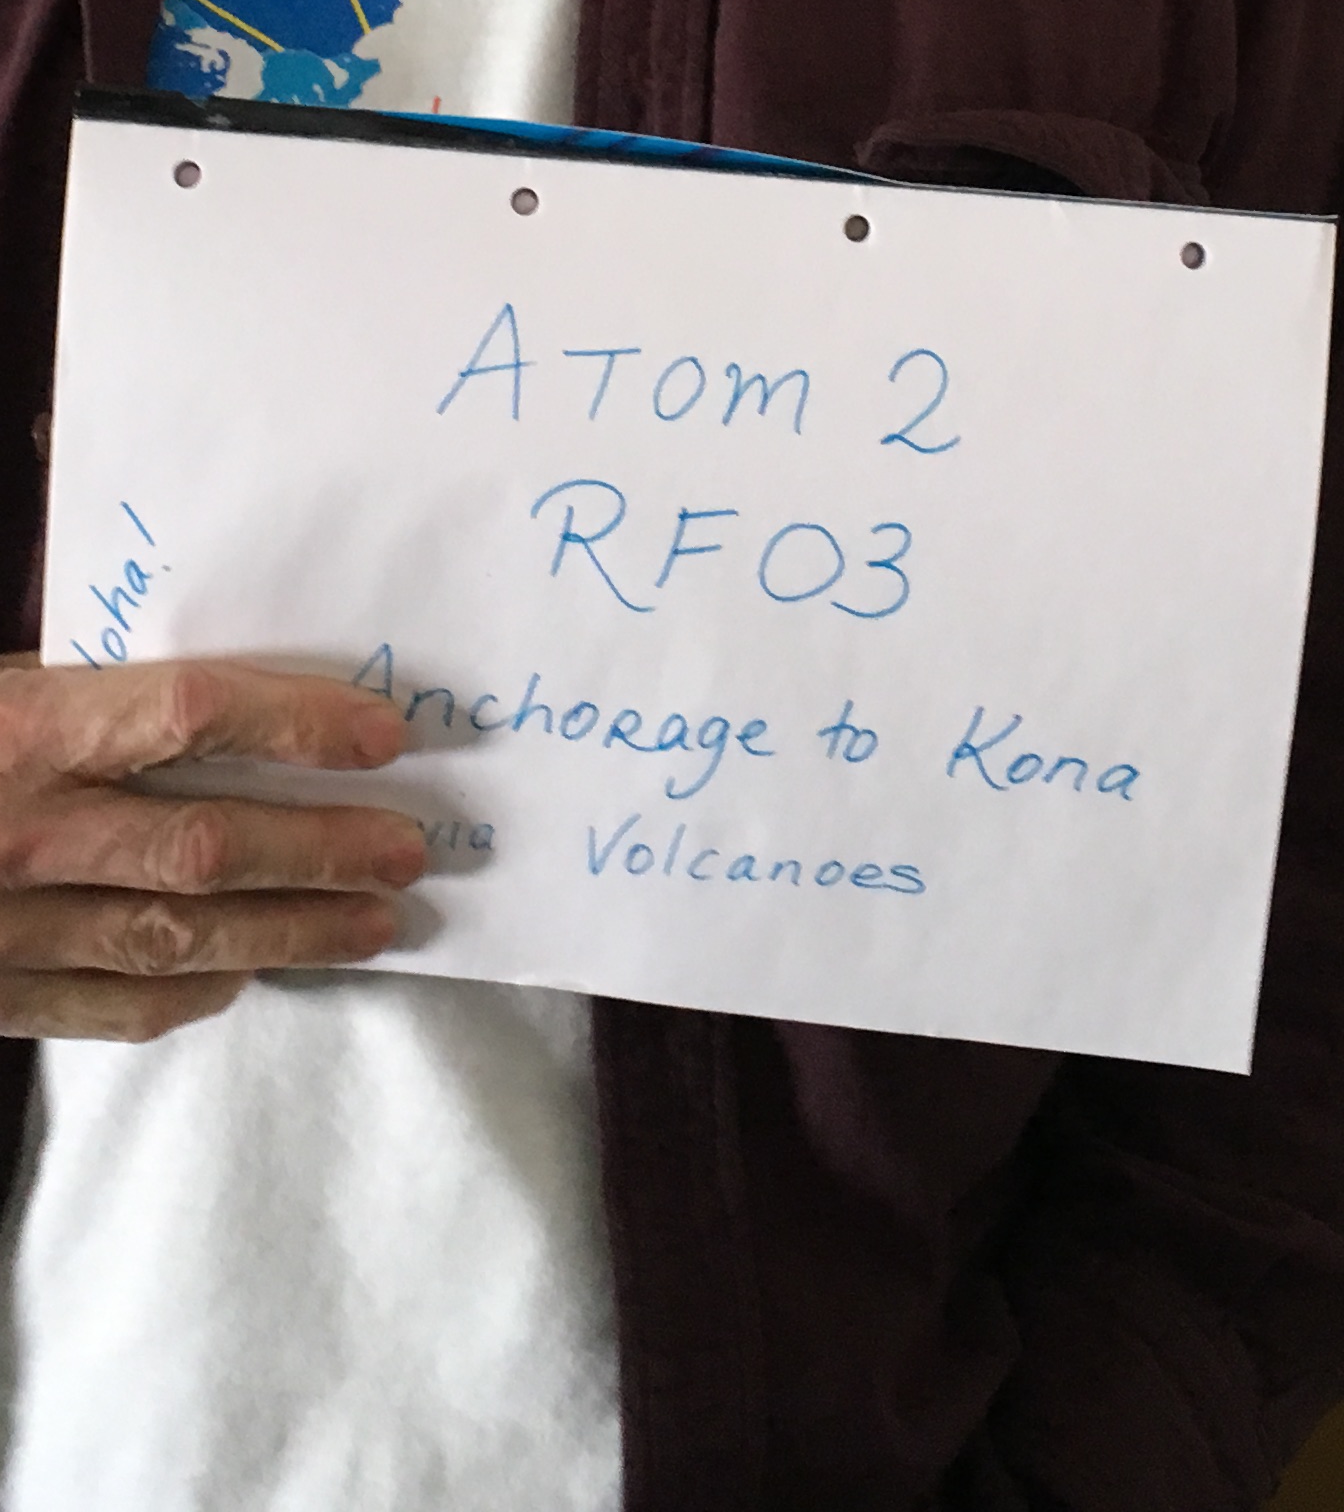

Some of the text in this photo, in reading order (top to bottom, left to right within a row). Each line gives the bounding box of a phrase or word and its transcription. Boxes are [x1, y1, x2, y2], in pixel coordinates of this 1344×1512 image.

[880, 347, 960, 455] 2
[70, 500, 172, 665] loha!
[816, 700, 878, 764] to
[945, 707, 1140, 802] Kona
[586, 815, 926, 896] Volcanoes
